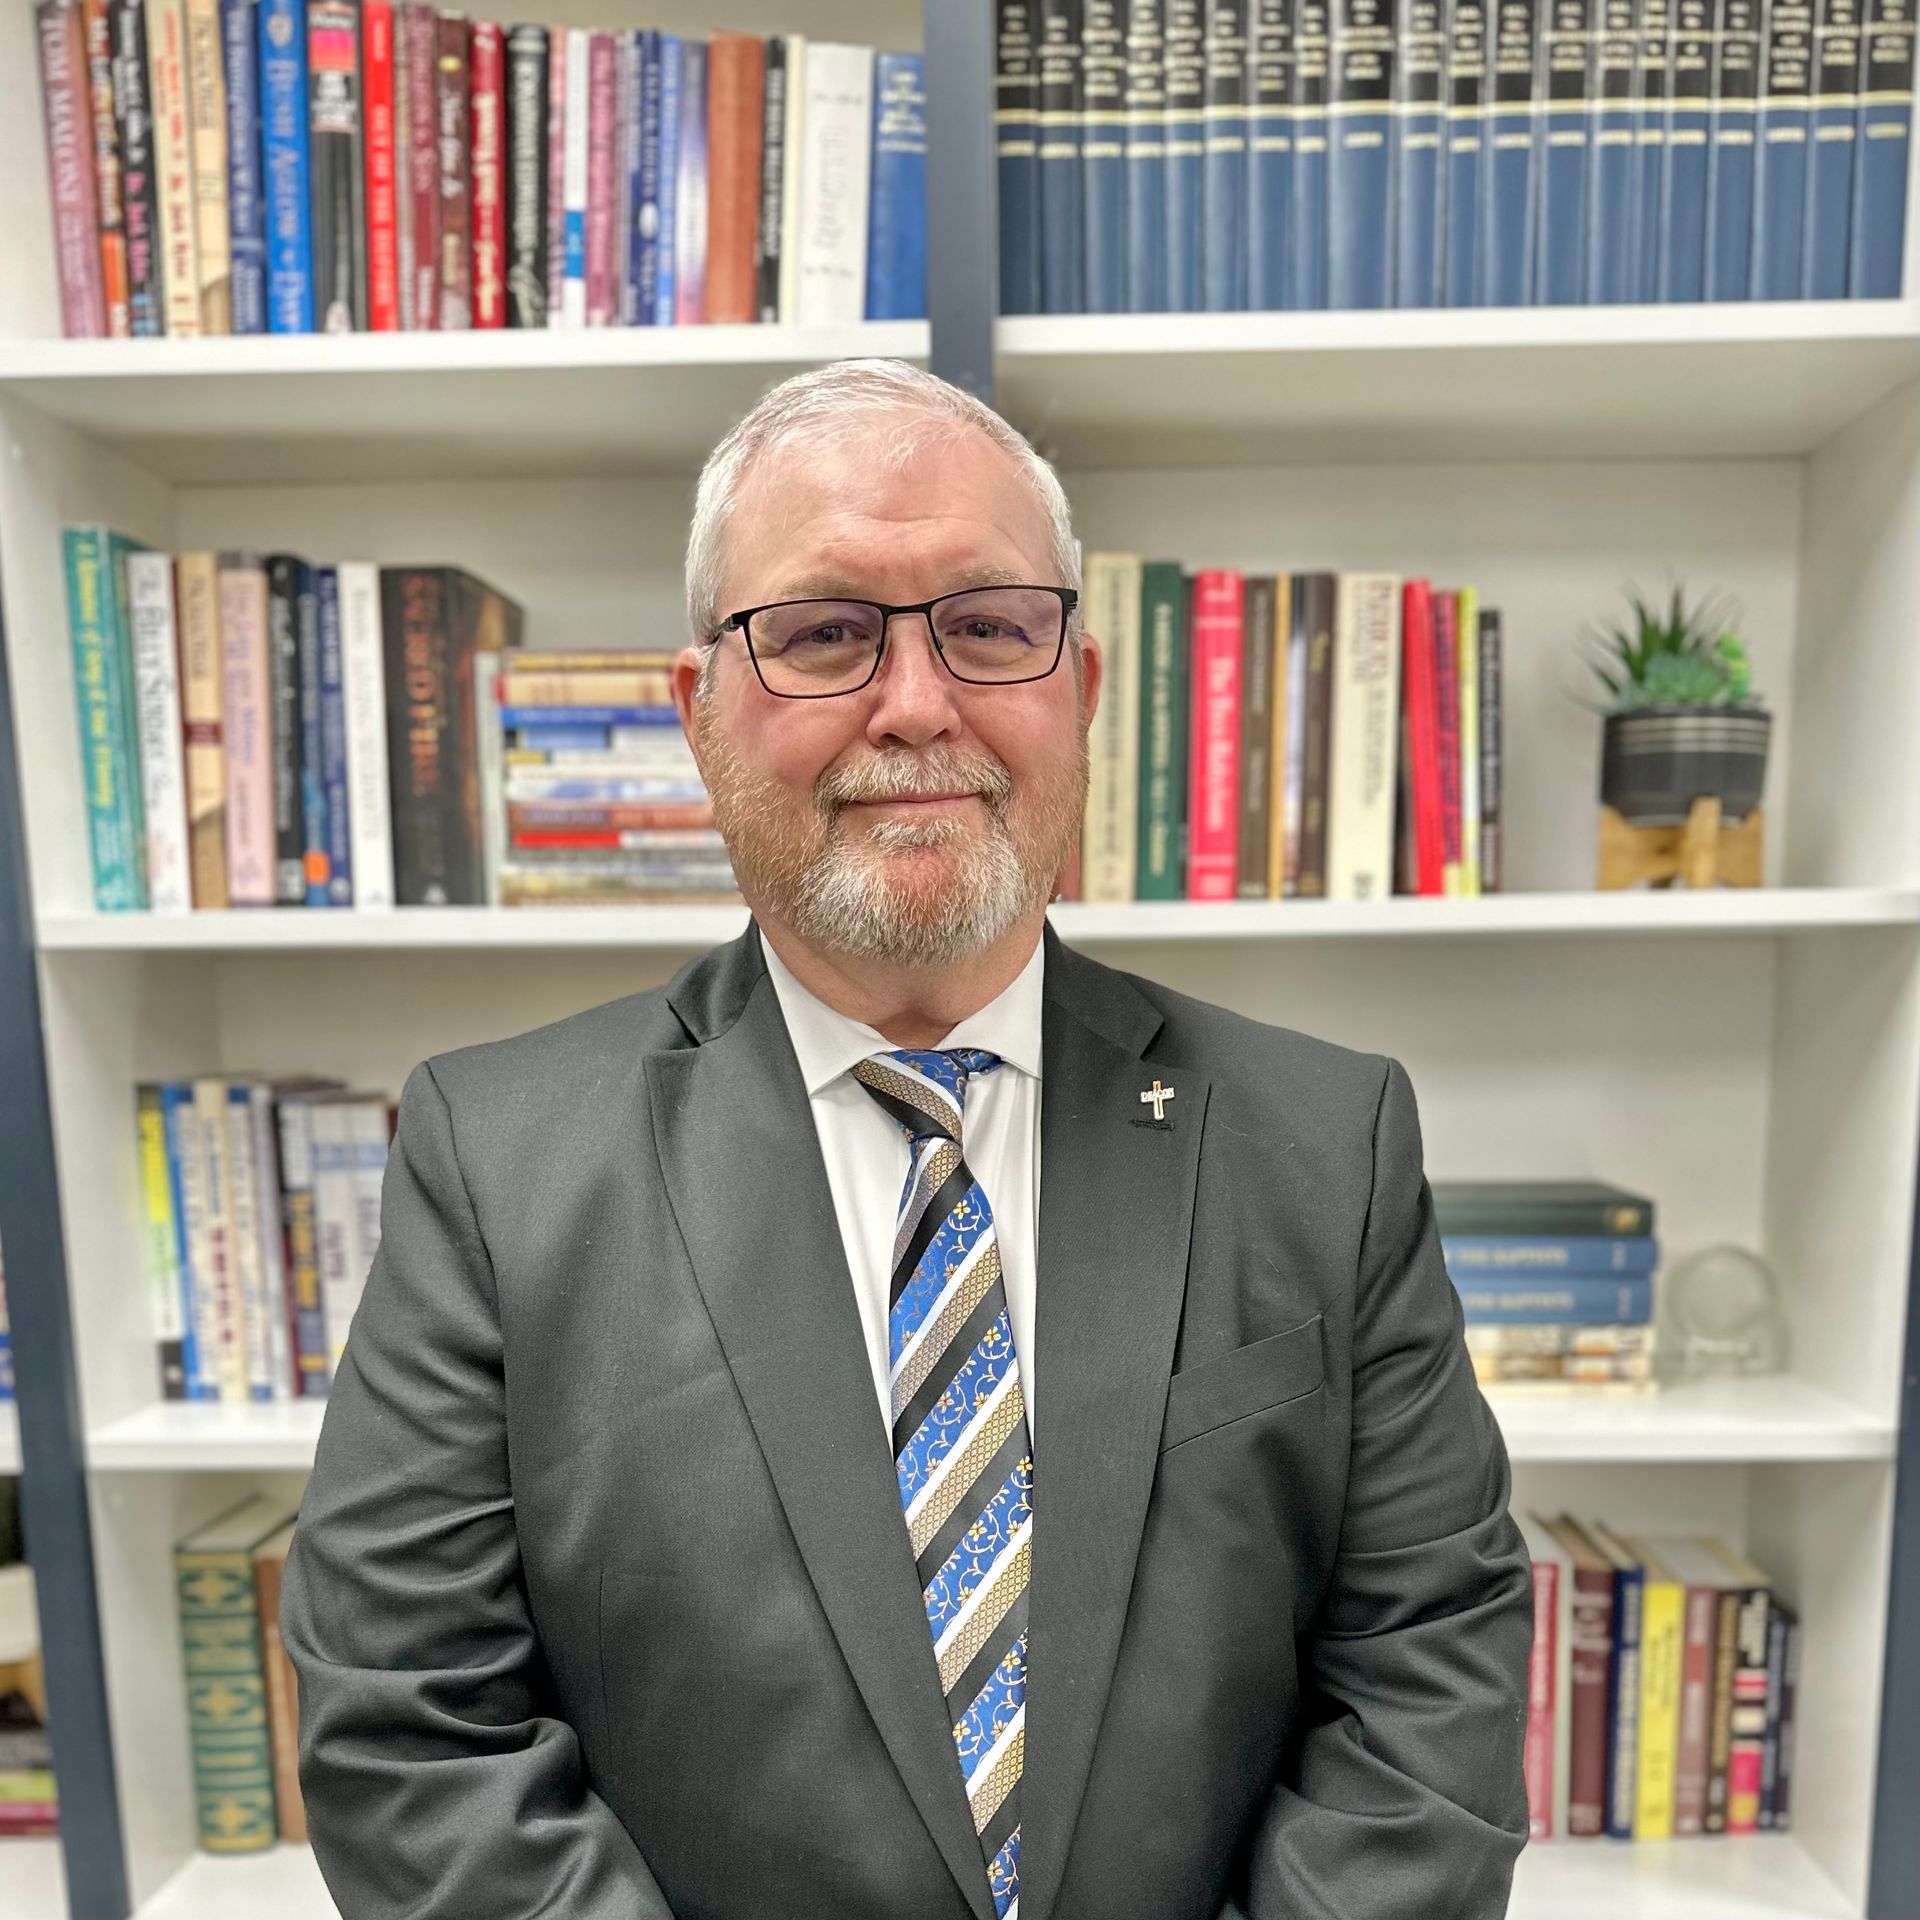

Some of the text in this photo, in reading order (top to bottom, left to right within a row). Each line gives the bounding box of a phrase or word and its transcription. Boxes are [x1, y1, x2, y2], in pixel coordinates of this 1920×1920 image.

[41, 17, 81, 205] TOM MALONE
[1141, 1087, 1175, 1102] DEACON
